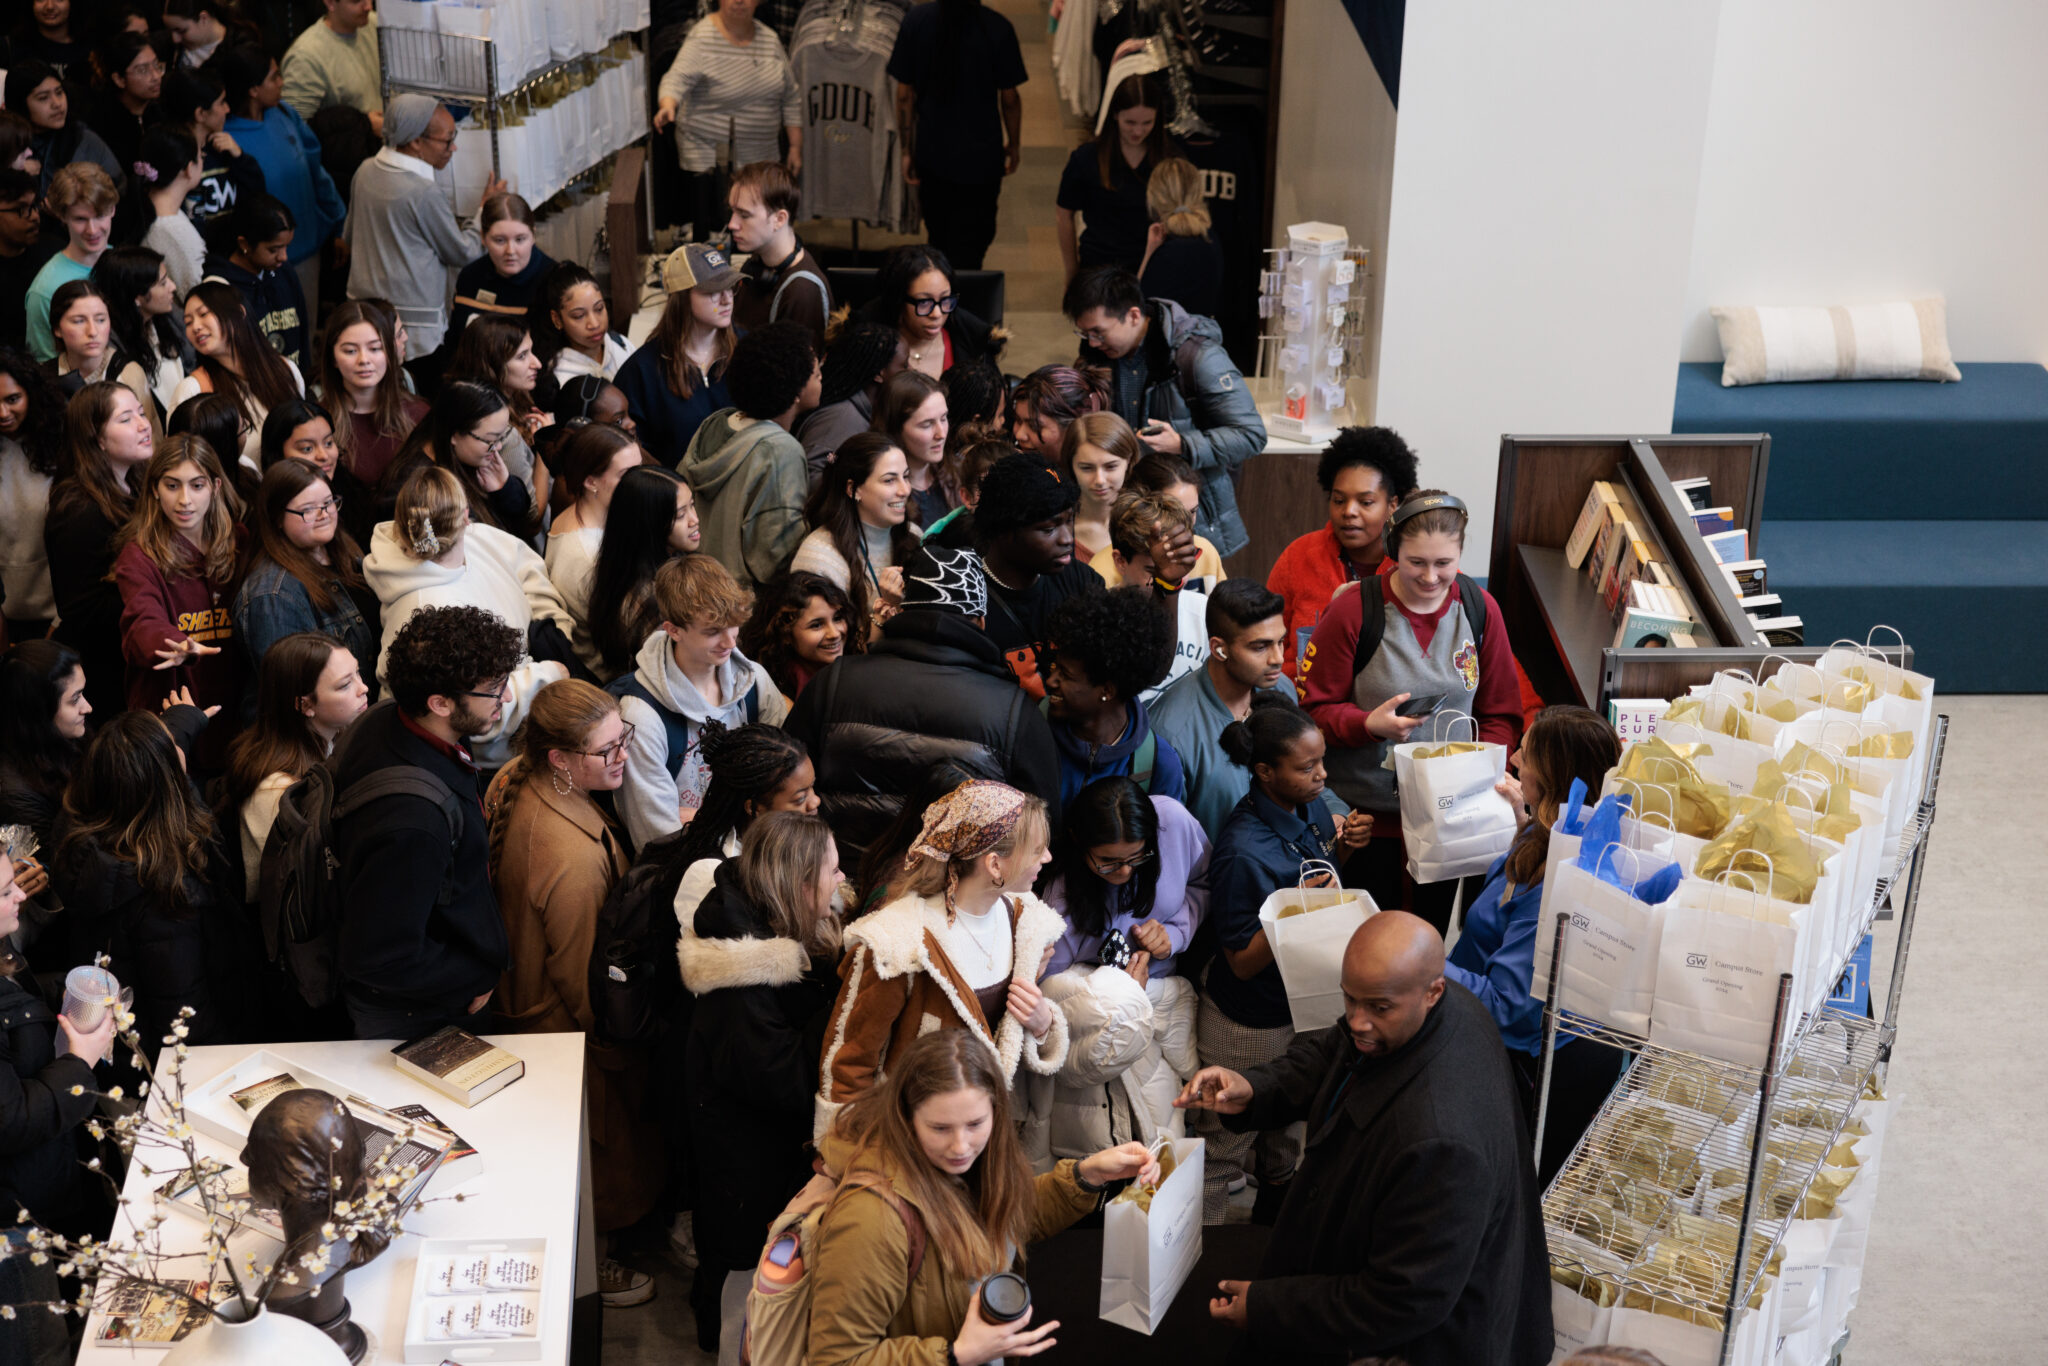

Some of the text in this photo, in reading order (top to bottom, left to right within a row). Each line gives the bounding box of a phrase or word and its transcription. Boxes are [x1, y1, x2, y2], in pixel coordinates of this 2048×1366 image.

[1630, 620, 1689, 634] BECOMING
[1620, 725, 1656, 734] SUR
[1438, 797, 1454, 808] GW
[1572, 914, 1590, 929] GW
[1686, 955, 1764, 976] GW Campus Store
